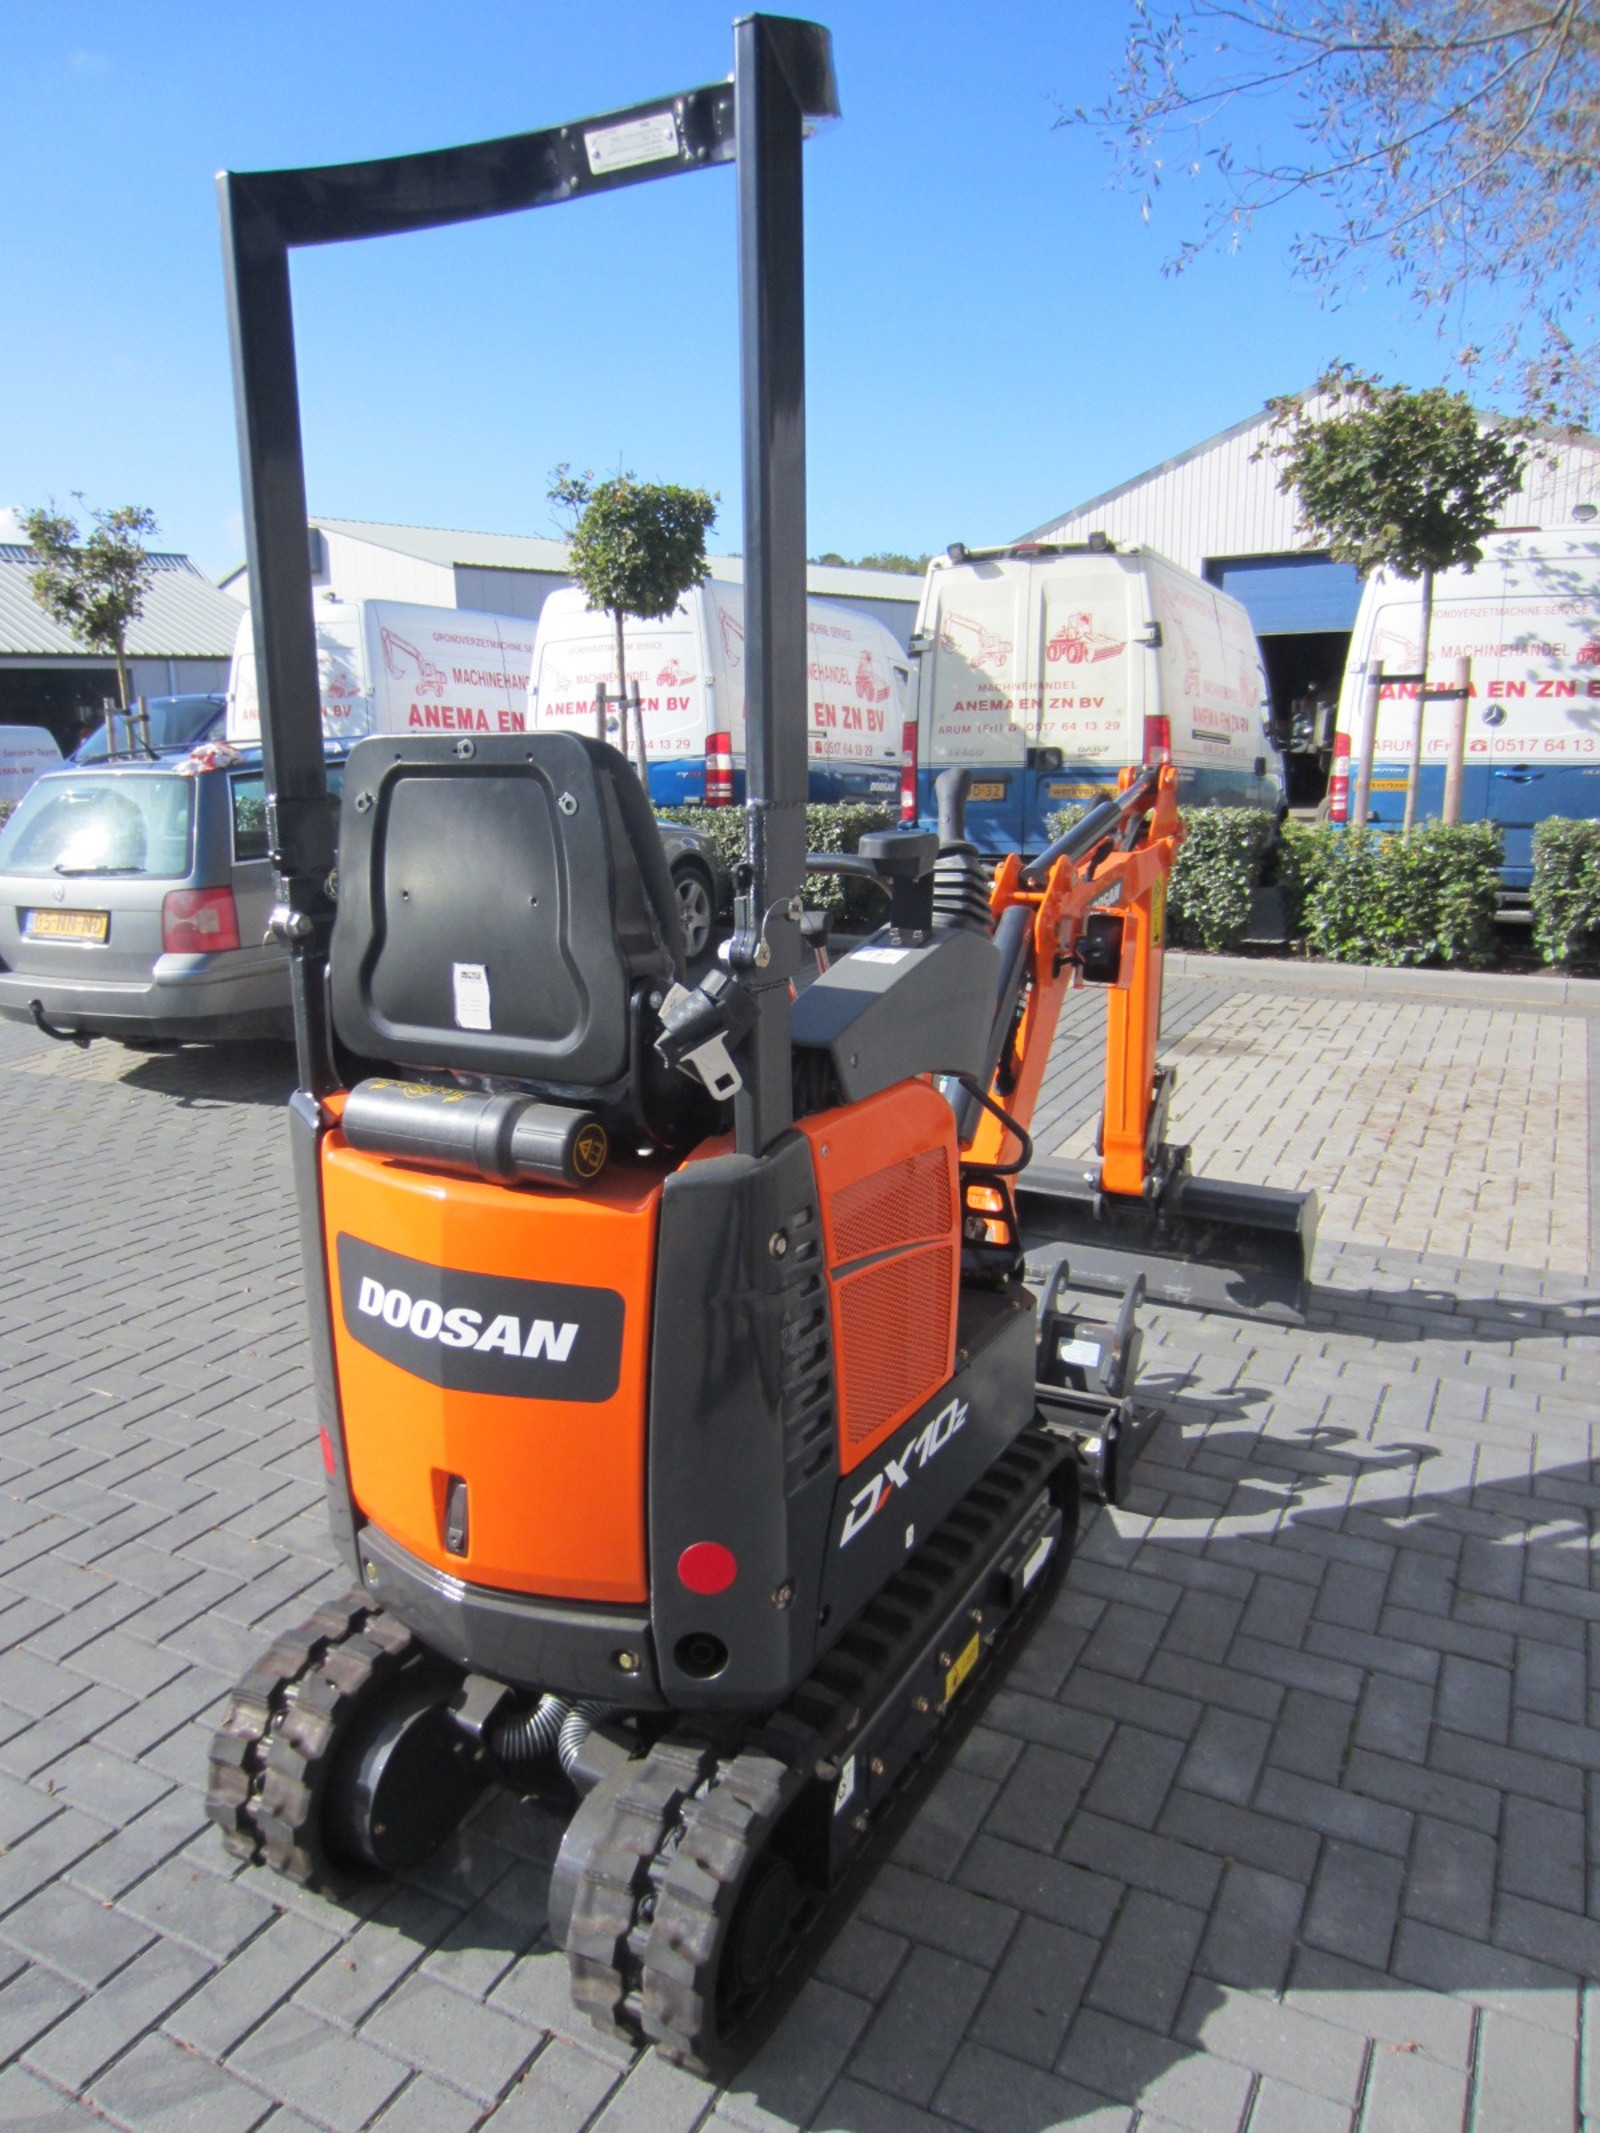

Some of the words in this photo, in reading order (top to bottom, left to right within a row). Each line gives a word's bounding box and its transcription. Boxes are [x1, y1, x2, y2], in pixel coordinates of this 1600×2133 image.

[1544, 604, 1588, 615] SERVICE
[1441, 642, 1571, 659] MACHINEHANDEL
[576, 671, 650, 685] MACHINEHNDEL
[978, 681, 1077, 693] MACHINEHANDEL
[1487, 681, 1526, 698] EN
[1536, 680, 1576, 698] ZN
[333, 705, 350, 717] BV
[667, 697, 690, 712] BV
[953, 700, 1014, 713] ANEMA
[1019, 698, 1043, 710] EN
[1049, 698, 1074, 709] ZN
[1079, 697, 1105, 709] BV
[409, 704, 490, 732] ANEMA
[498, 711, 526, 732] EN
[814, 703, 837, 728] EN
[842, 706, 863, 730] ZN
[867, 709, 884, 732] BV
[938, 725, 971, 735] ARUM
[1062, 722, 1077, 732] 64
[1084, 721, 1097, 731] 13
[1105, 721, 1121, 731] 29
[660, 739, 671, 750] 13
[676, 738, 690, 750] 29
[1495, 739, 1538, 752] 0517
[1544, 739, 1566, 752] 64
[1573, 739, 1594, 752] 13
[358, 1276, 579, 1362] DOOSAN
